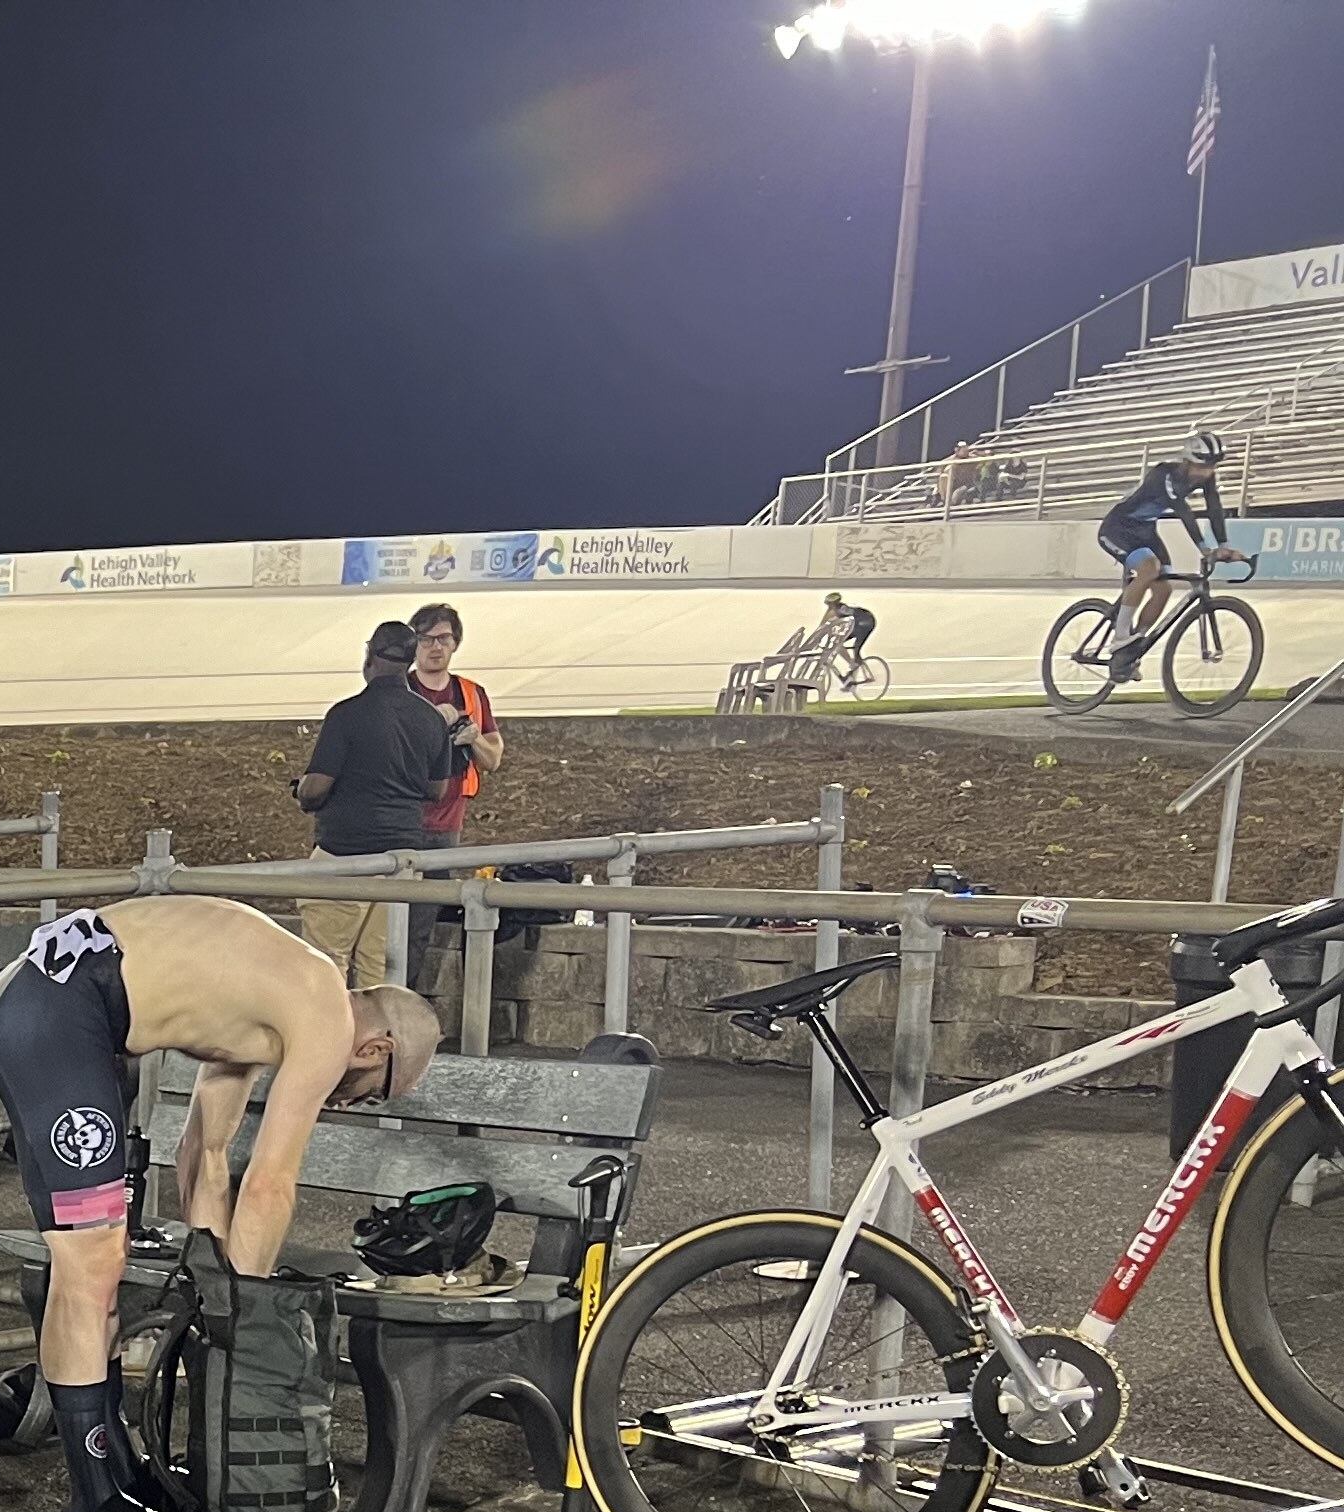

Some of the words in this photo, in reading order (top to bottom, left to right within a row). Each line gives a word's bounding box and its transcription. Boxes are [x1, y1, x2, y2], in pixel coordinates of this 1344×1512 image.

[1291, 253, 1344, 288] Val
[571, 535, 625, 558] Lehigh
[627, 537, 673, 558] Valley
[90, 555, 136, 574] Lehigh
[138, 553, 181, 573] Valley
[569, 555, 620, 575] Health
[622, 554, 690, 575] Network
[89, 571, 134, 589] Health
[136, 568, 197, 586] Network
